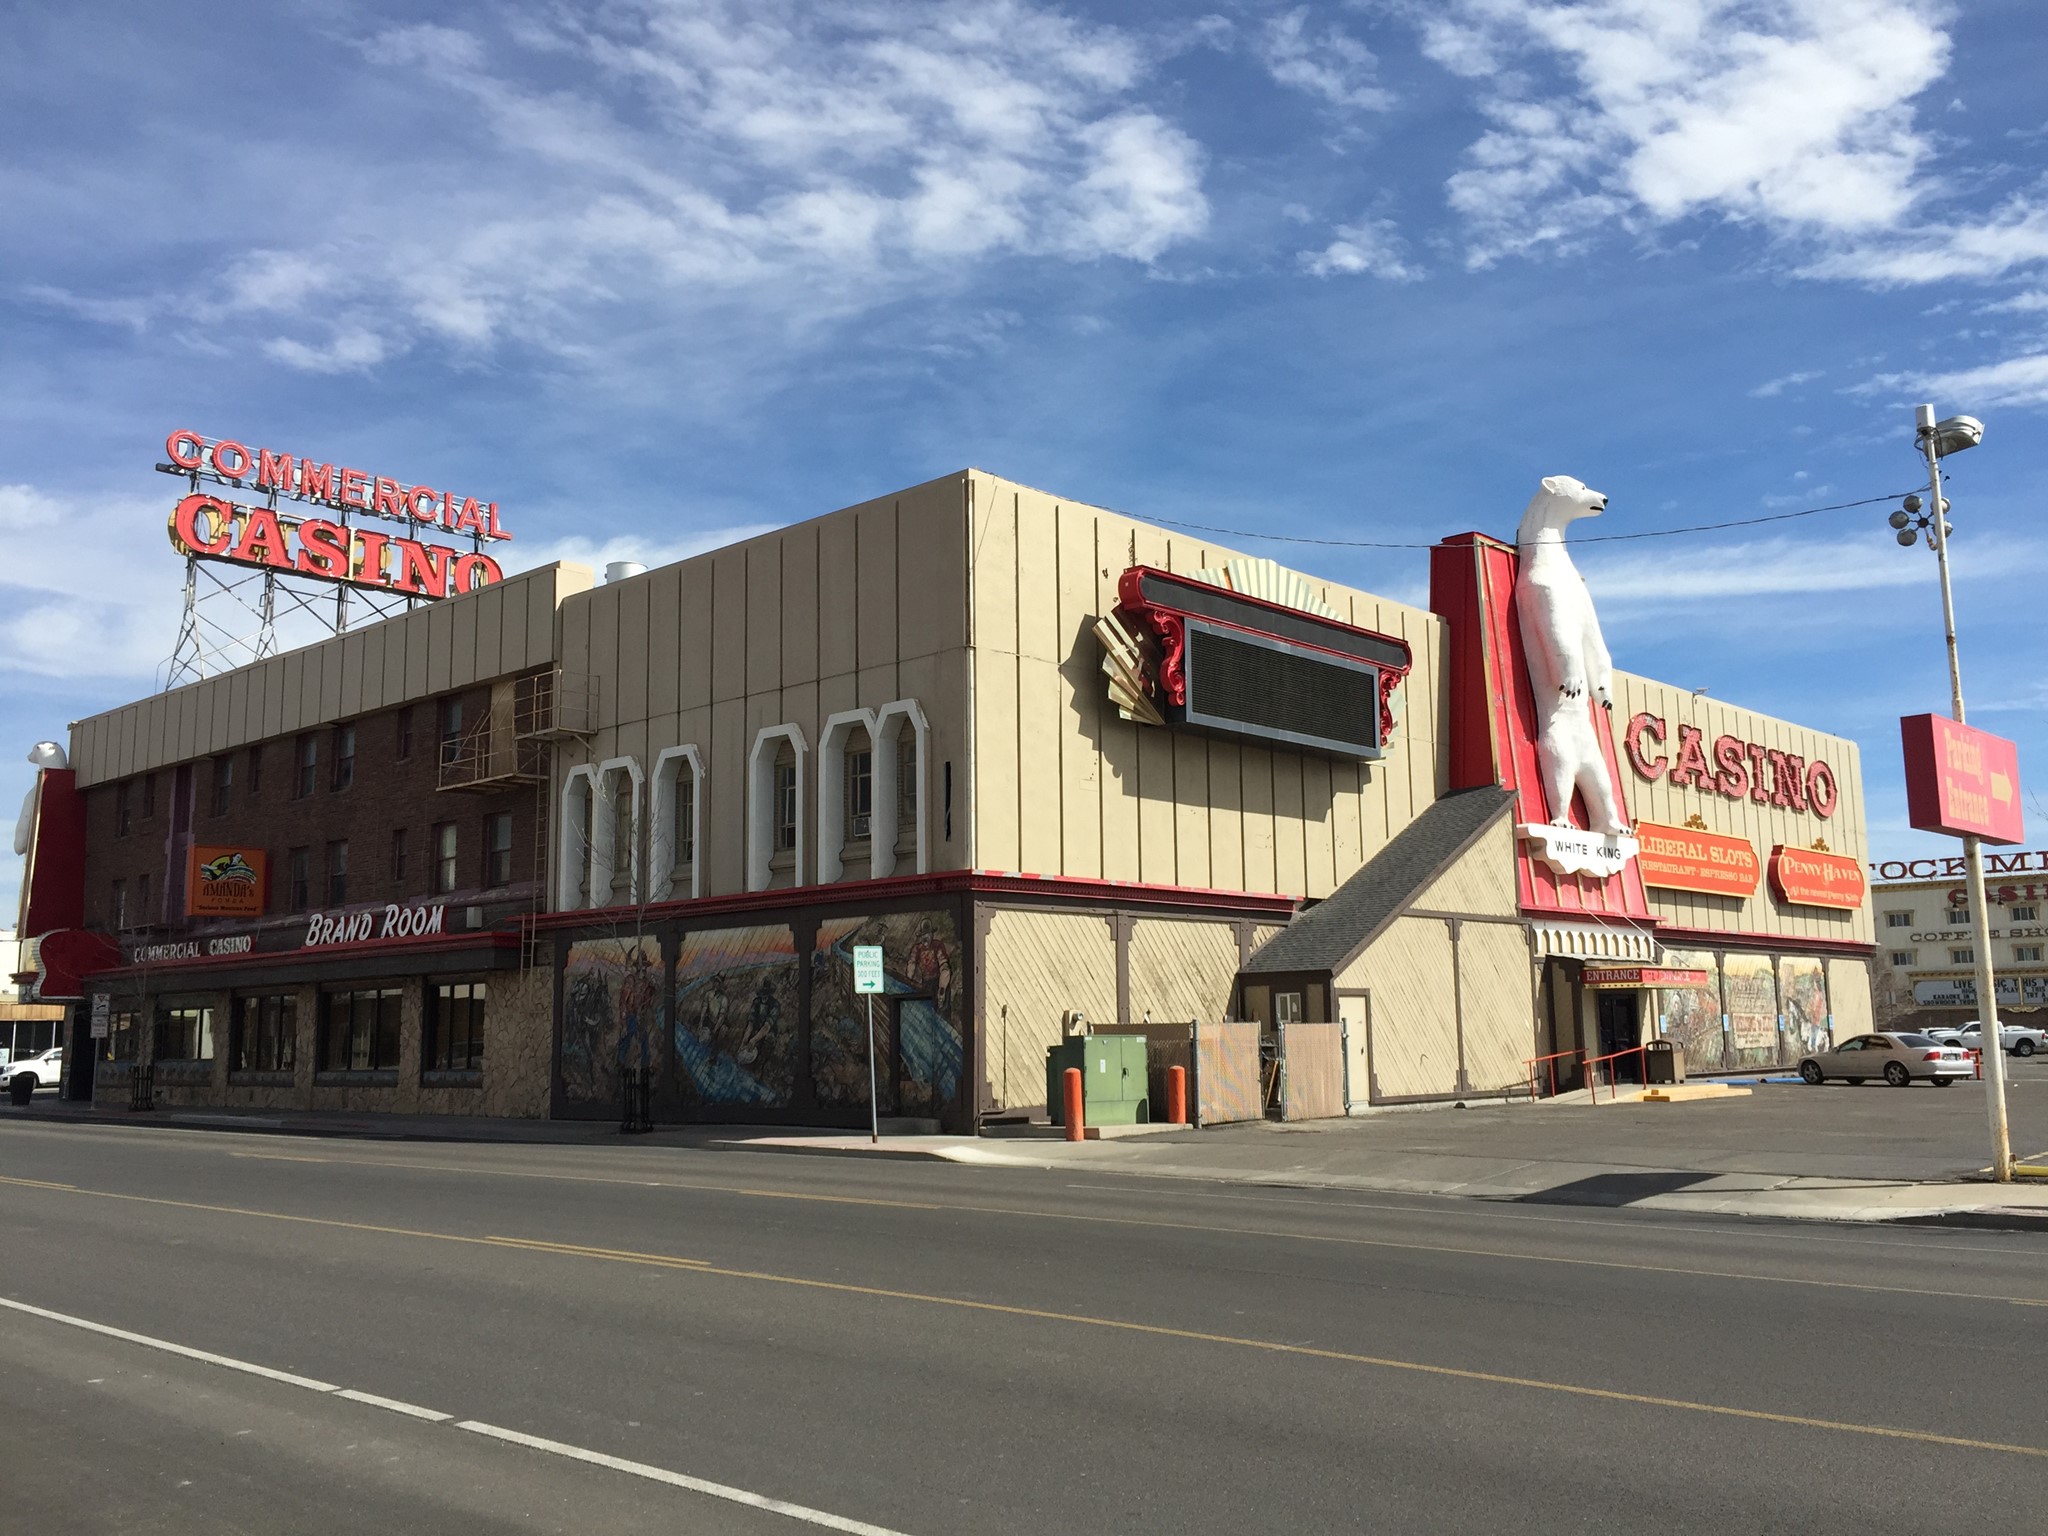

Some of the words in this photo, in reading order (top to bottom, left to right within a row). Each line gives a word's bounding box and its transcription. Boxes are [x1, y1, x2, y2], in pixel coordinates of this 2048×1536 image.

[166, 429, 513, 541] COMMERCIAL
[175, 494, 504, 599] CASINO
[1624, 712, 1838, 818] CASINO
[1555, 840, 1588, 855] WHITE
[1596, 846, 1621, 860] KING
[1639, 835, 1708, 862] LIBERAL
[1710, 846, 1753, 868] SLOTS
[1641, 861, 1698, 879] RESTAURANT
[1700, 868, 1738, 882] ESPRESSO
[1739, 873, 1754, 884] BAR
[1783, 856, 1822, 876] PENNY
[1822, 862, 1861, 885] HAVEN
[305, 912, 373, 947] BRAND
[380, 903, 445, 939] ROOM
[134, 941, 200, 963] COMMERCIAL
[209, 935, 252, 957] CASINO
[1586, 969, 1640, 981] ENTRANCE
[1953, 979, 1973, 989] LIVE
